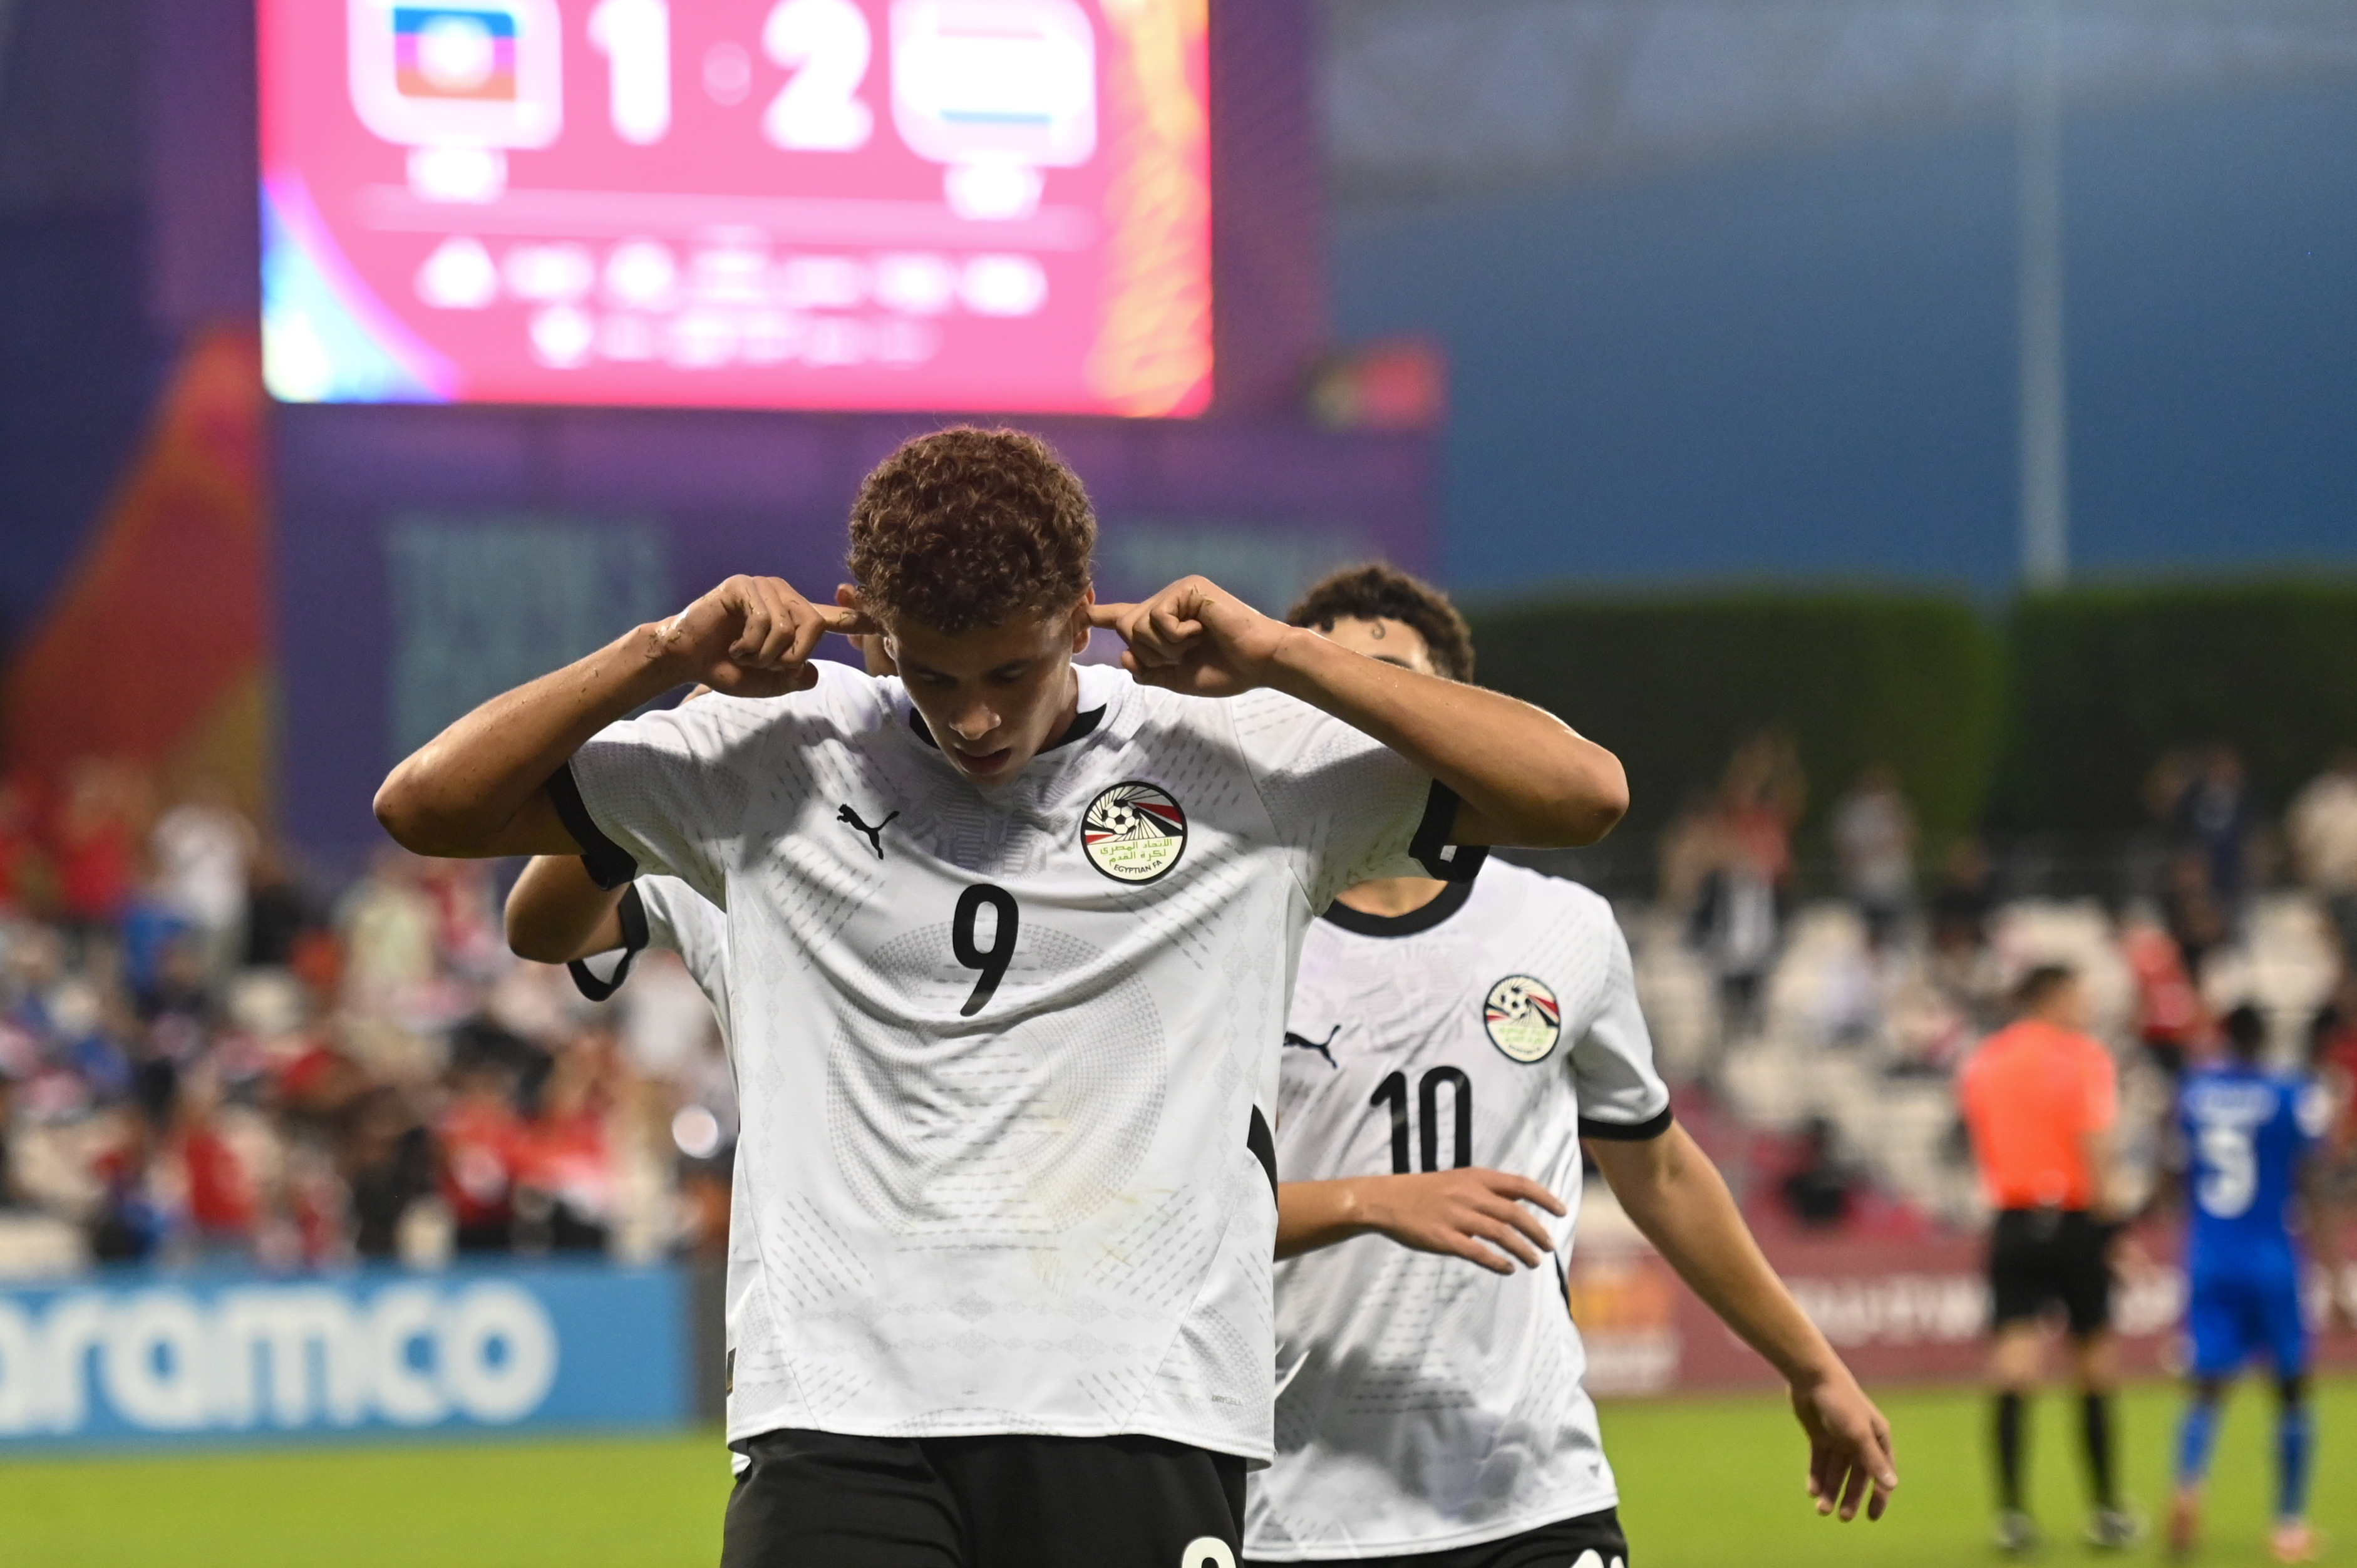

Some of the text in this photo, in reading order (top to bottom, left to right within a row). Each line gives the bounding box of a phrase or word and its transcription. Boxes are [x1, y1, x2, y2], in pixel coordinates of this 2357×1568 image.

[587, 0, 874, 150] 1 2
[1109, 848, 1166, 866] لكرة القدم
[1114, 860, 1162, 874] EGYPTIAN FA
[1143, 838, 1172, 848] الاتحاد
[952, 884, 1019, 1017] 9
[1370, 1066, 1472, 1175] 10
